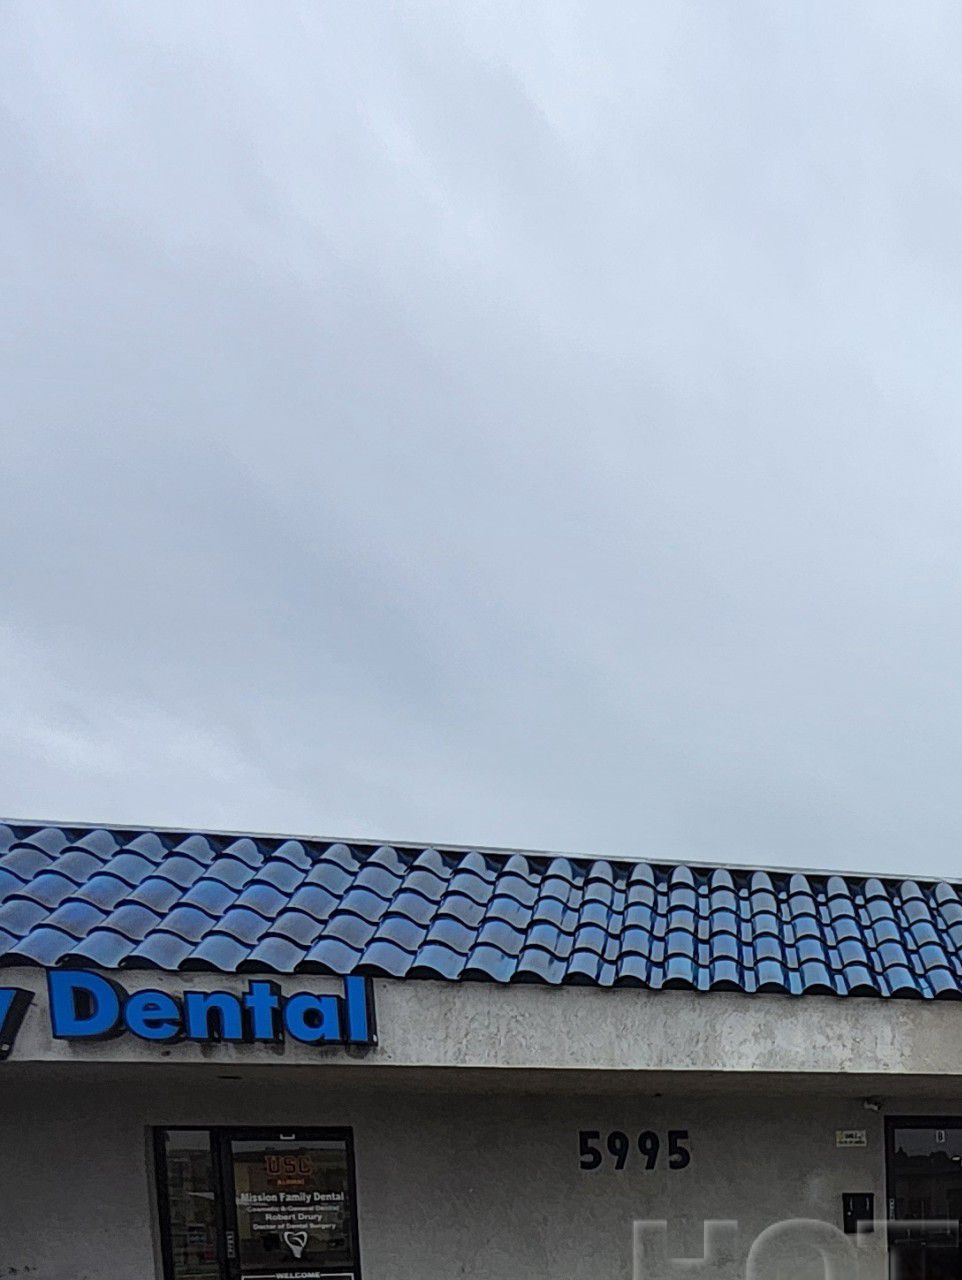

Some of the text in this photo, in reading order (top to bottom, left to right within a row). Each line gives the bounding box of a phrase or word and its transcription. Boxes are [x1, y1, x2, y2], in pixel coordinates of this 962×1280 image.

[47, 968, 371, 1044] Dental
[578, 1129, 691, 1170] 5995
[265, 1155, 312, 1176] USC
[240, 1192, 344, 1203] Mission Family Dental
[265, 1213, 322, 1222] Robert Drury
